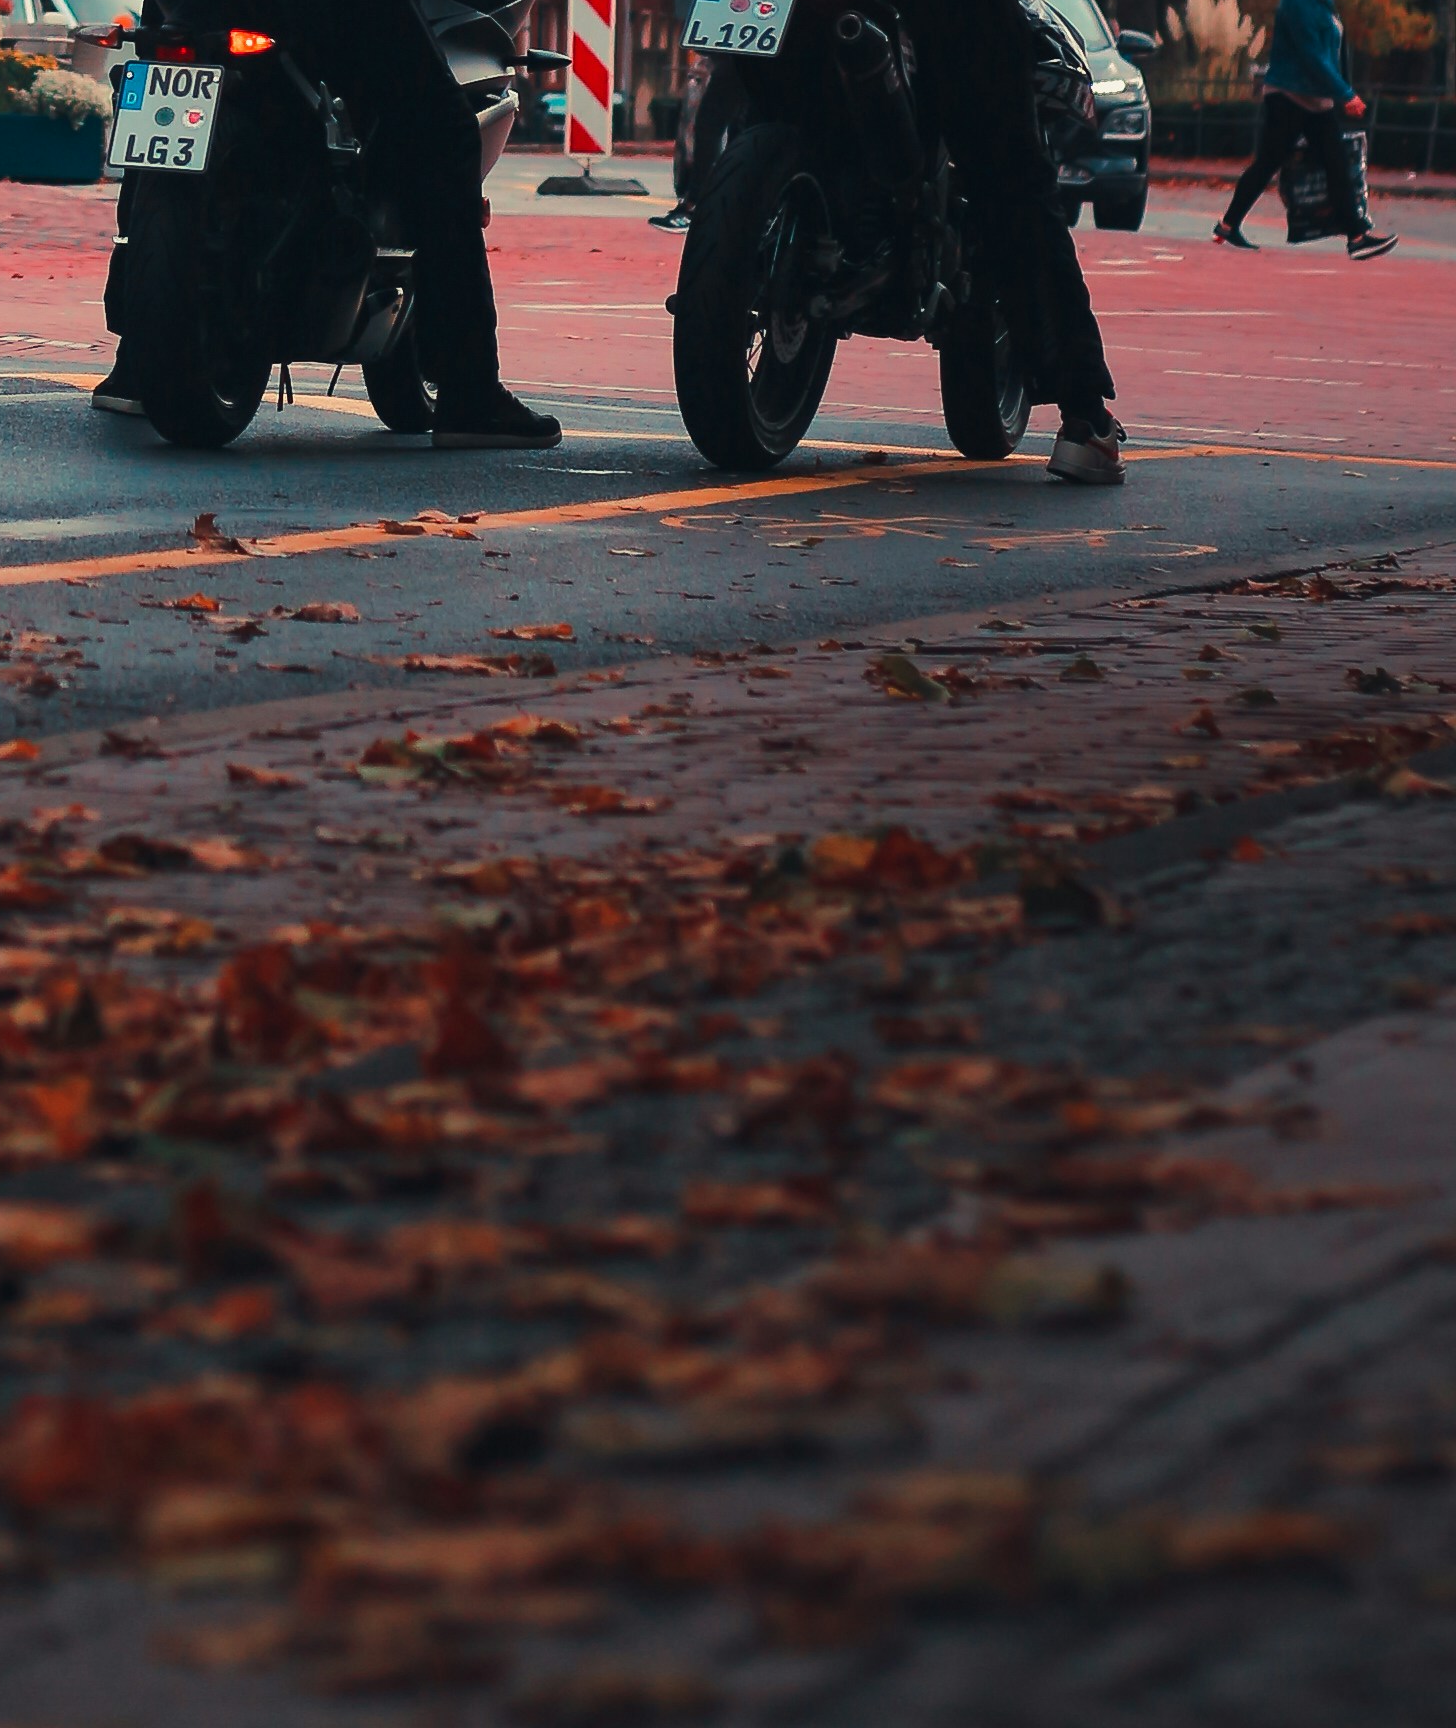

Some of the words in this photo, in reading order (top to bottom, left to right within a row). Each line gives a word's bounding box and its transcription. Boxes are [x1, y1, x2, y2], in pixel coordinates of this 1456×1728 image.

[688, 20, 708, 45] L
[714, 22, 777, 51] 196
[126, 92, 137, 104] D
[149, 67, 214, 99] NOR
[125, 134, 169, 165] LG
[173, 138, 195, 166] 3
